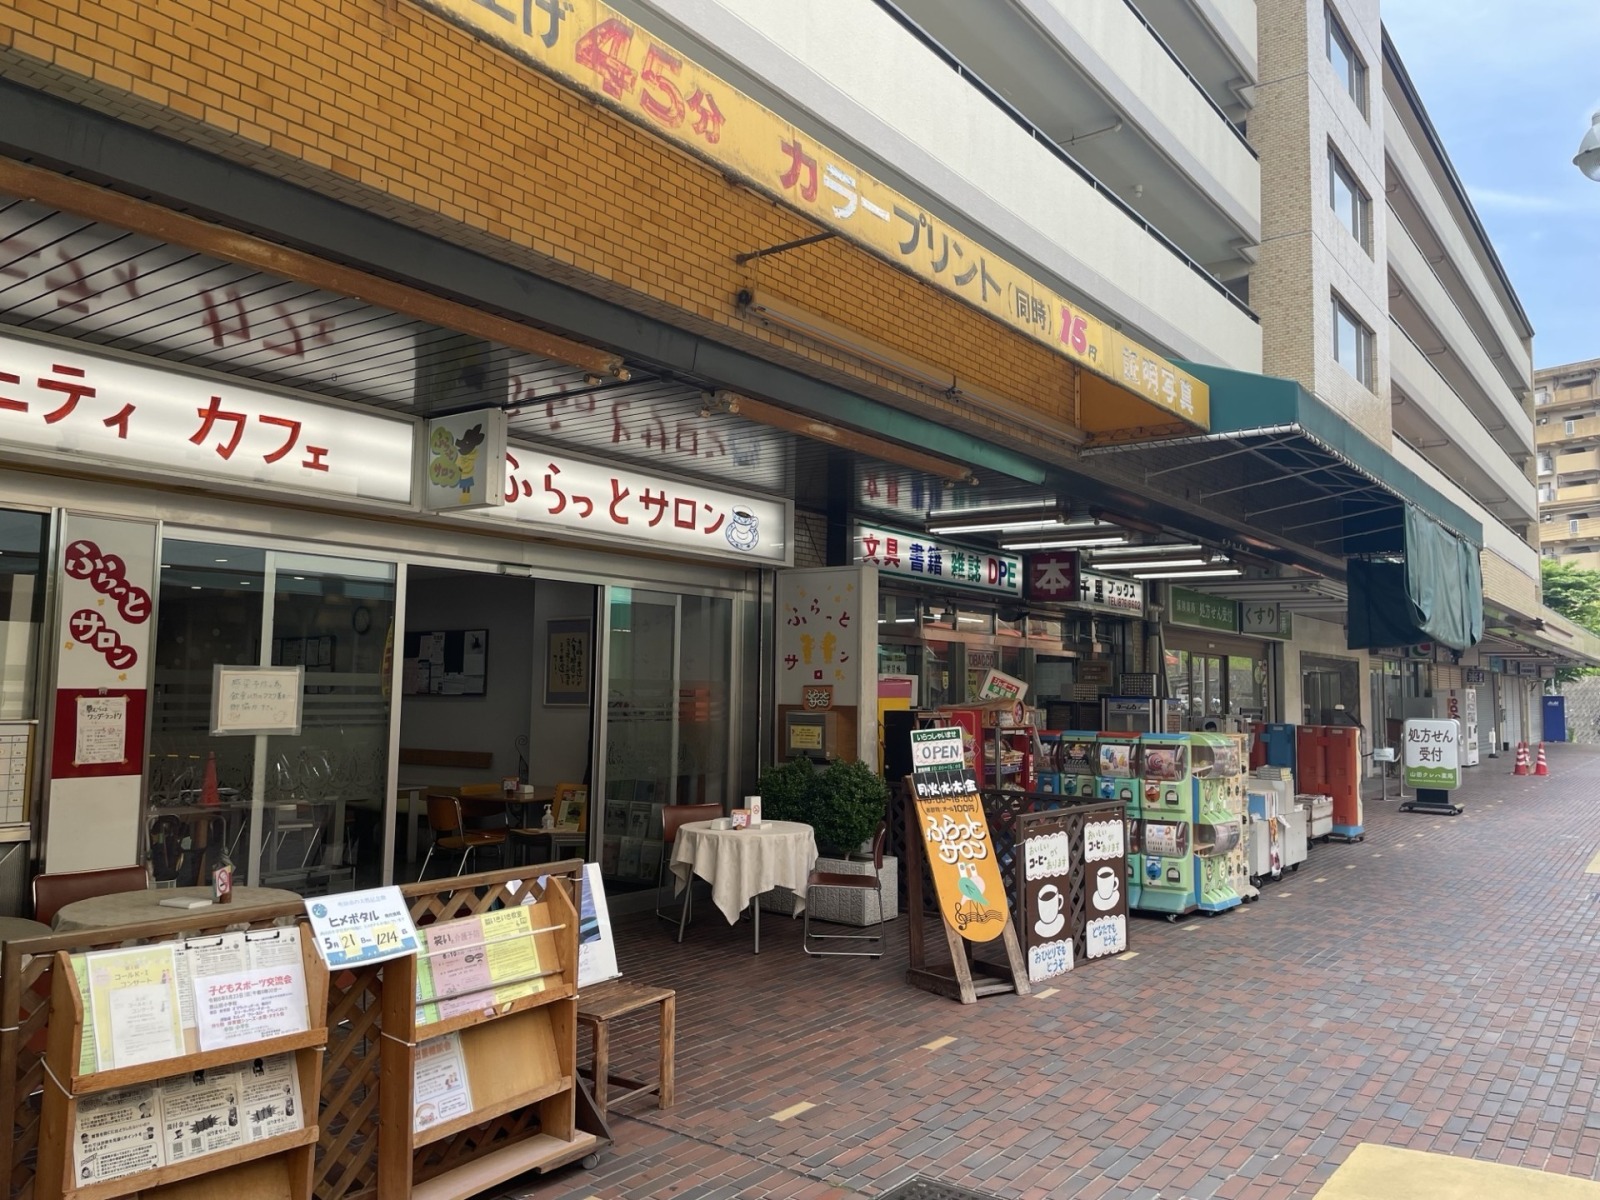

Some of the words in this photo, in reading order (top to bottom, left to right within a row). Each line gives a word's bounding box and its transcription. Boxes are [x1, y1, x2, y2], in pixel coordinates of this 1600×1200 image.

[574, 17, 727, 145] 45分
[780, 139, 1002, 302] カラープリント
[1122, 345, 1195, 415] 証明写真
[189, 396, 330, 472] カフェ
[863, 534, 900, 568] 文具
[909, 542, 943, 576] 書籍
[950, 551, 982, 584] 雑誌
[988, 557, 1017, 589] DPE
[65, 542, 145, 617] ふらっと
[1034, 558, 1071, 595] 本
[1080, 576, 1105, 603] 千里
[787, 598, 851, 628] ふらっと
[1245, 607, 1275, 625] くすり
[72, 612, 132, 667] サロン
[916, 731, 957, 741] いらっしゃいませ
[1408, 727, 1454, 743] 処方せん
[922, 745, 959, 760] OPEN
[1419, 746, 1443, 762] 受付
[926, 812, 987, 842] ふらっと
[938, 839, 988, 864] サロン
[328, 910, 380, 928] ヒメボタル
[341, 933, 356, 949] 21
[376, 931, 398, 946] 1214
[208, 974, 293, 997] 子どもスポーツ交流会
